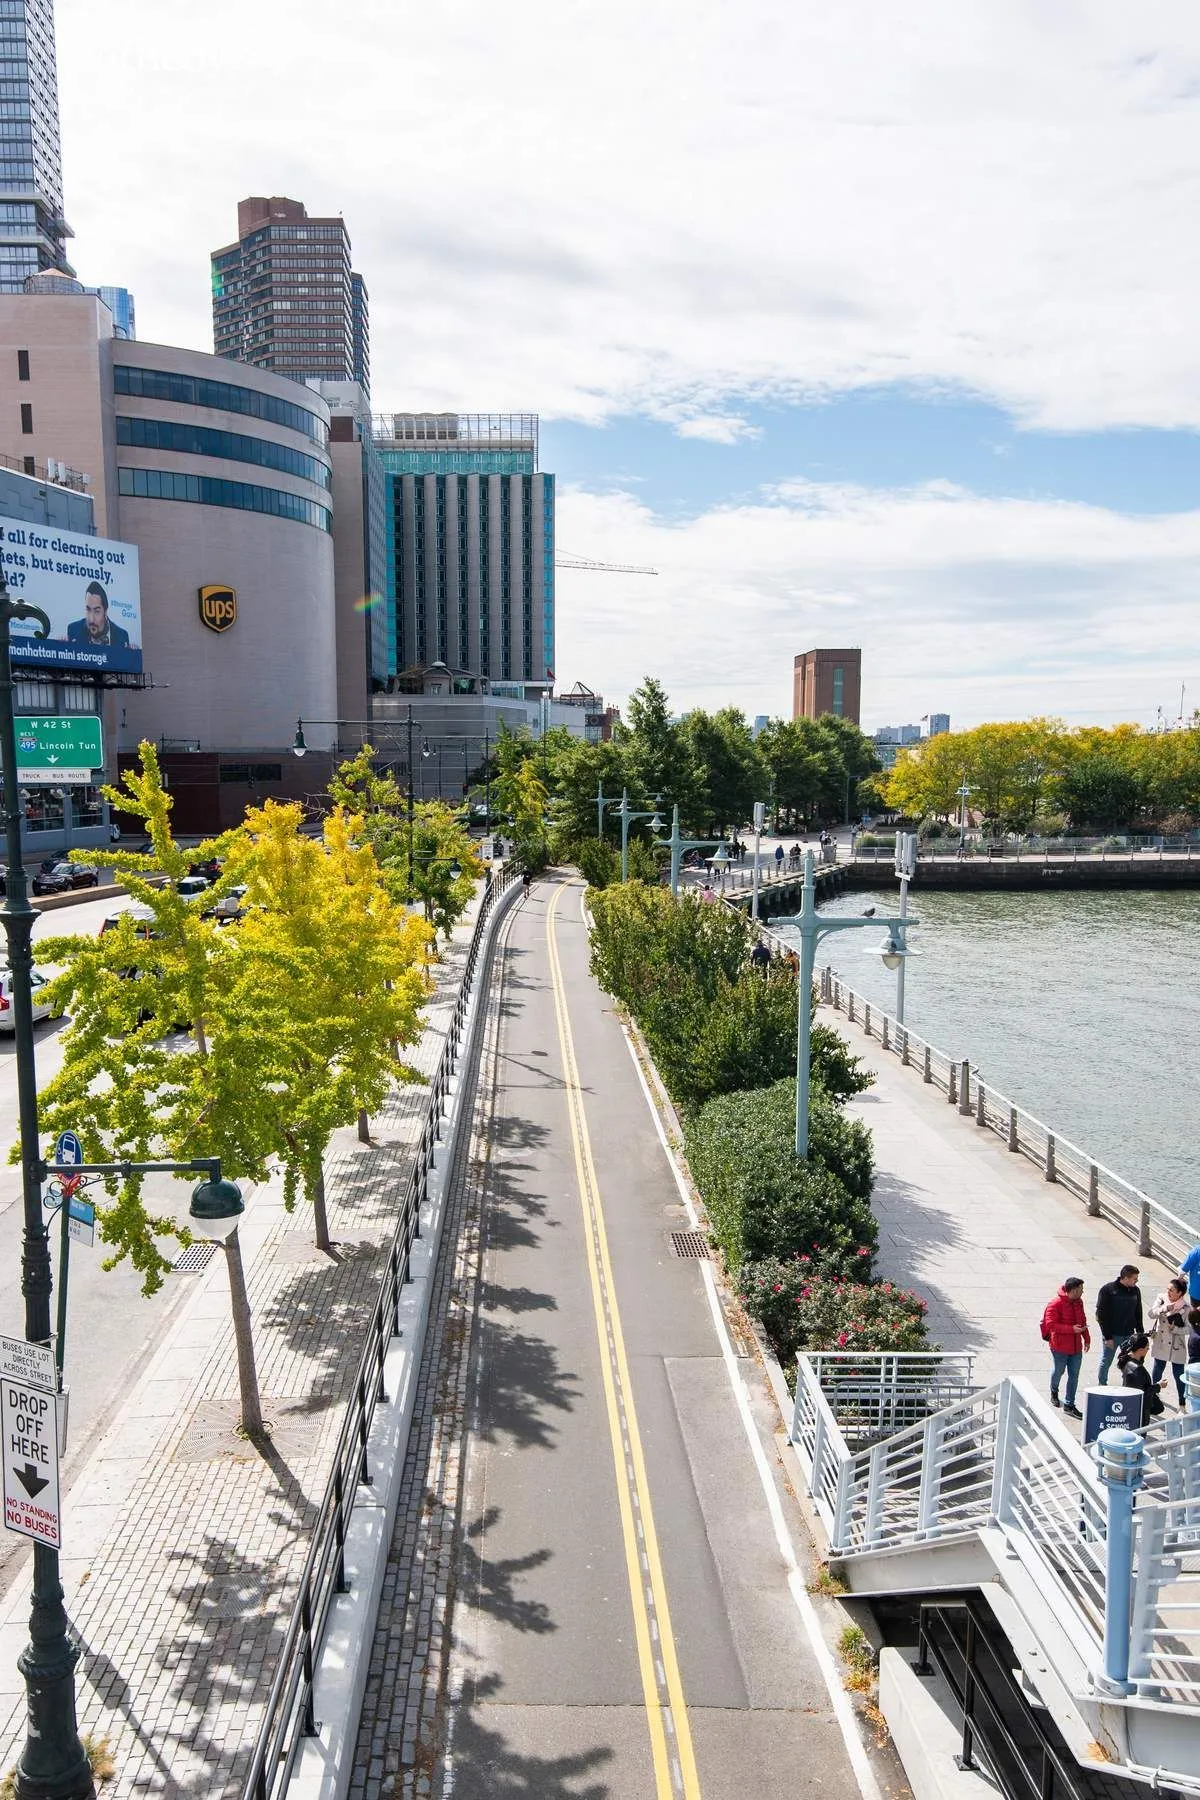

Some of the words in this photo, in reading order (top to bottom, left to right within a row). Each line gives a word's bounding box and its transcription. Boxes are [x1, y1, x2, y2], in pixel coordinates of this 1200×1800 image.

[8, 529, 26, 545] all
[29, 532, 49, 549] for
[51, 538, 104, 565] cleaning
[107, 551, 125, 565] out
[32, 553, 53, 572] but
[56, 562, 114, 585] seriously,
[205, 600, 234, 625] ups
[9, 641, 57, 659] manhattan
[58, 649, 75, 660] mini
[77, 650, 108, 665] storage
[43, 721, 57, 729] 42
[61, 721, 72, 729] St
[20, 741, 36, 749] 495
[40, 742, 74, 750] Lincoln
[78, 742, 96, 750] Tun
[3, 1341, 22, 1354] BUSES
[24, 1347, 36, 1359] USE
[38, 1352, 49, 1362] LOT
[12, 1354, 40, 1369] DIRECTLY
[4, 1362, 27, 1376] ACROSS
[29, 1369, 52, 1384] STREET
[9, 1389, 48, 1417] DROP
[16, 1414, 43, 1438] OFF
[11, 1434, 49, 1464] HERE
[6, 1496, 18, 1508] NO
[20, 1502, 57, 1524] STANDING
[7, 1510, 22, 1525] NO
[25, 1516, 57, 1539] BUSES
